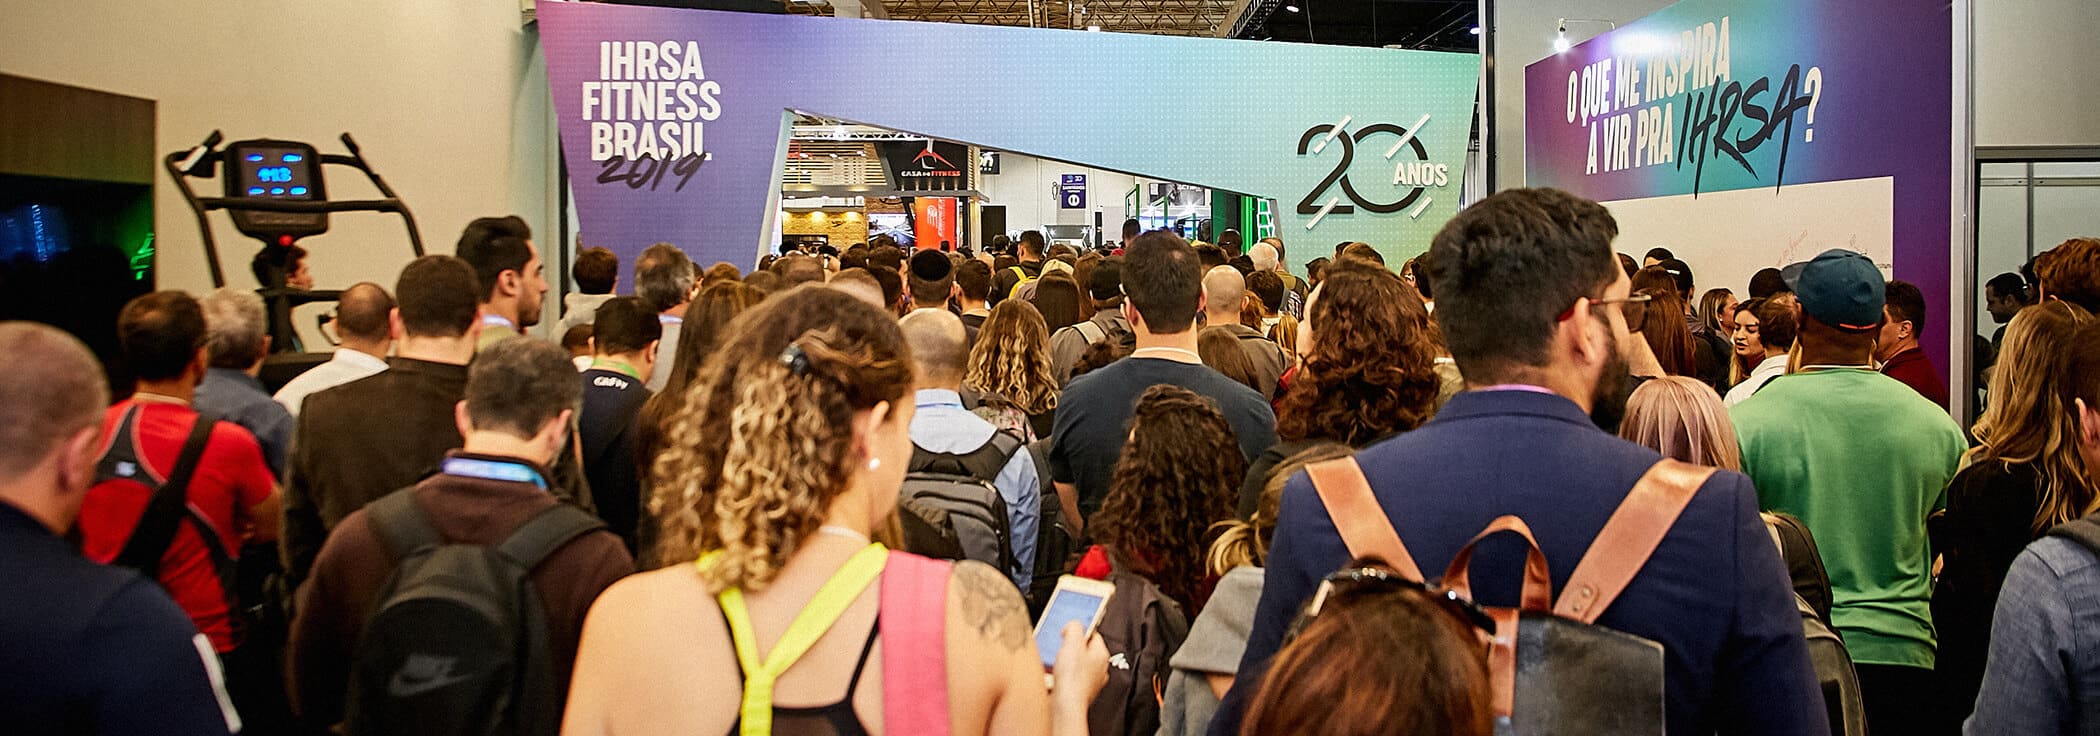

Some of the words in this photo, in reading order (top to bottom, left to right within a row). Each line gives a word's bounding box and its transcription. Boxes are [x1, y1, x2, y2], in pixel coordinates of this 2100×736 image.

[600, 40, 705, 80] IHRSA
[1567, 70, 1578, 124] O
[1580, 58, 1612, 127] QUE
[1614, 51, 1640, 112] ME
[1645, 16, 1730, 103] INSPIRA
[582, 80, 722, 121] FITNESS
[591, 121, 712, 161] BRASIL
[1586, 121, 1598, 176] A
[1603, 113, 1632, 173] VIR
[1635, 102, 1673, 168] PRA
[596, 150, 707, 193] 2019
[1296, 123, 1429, 214] 20
[1393, 162, 1449, 188] ANOS
